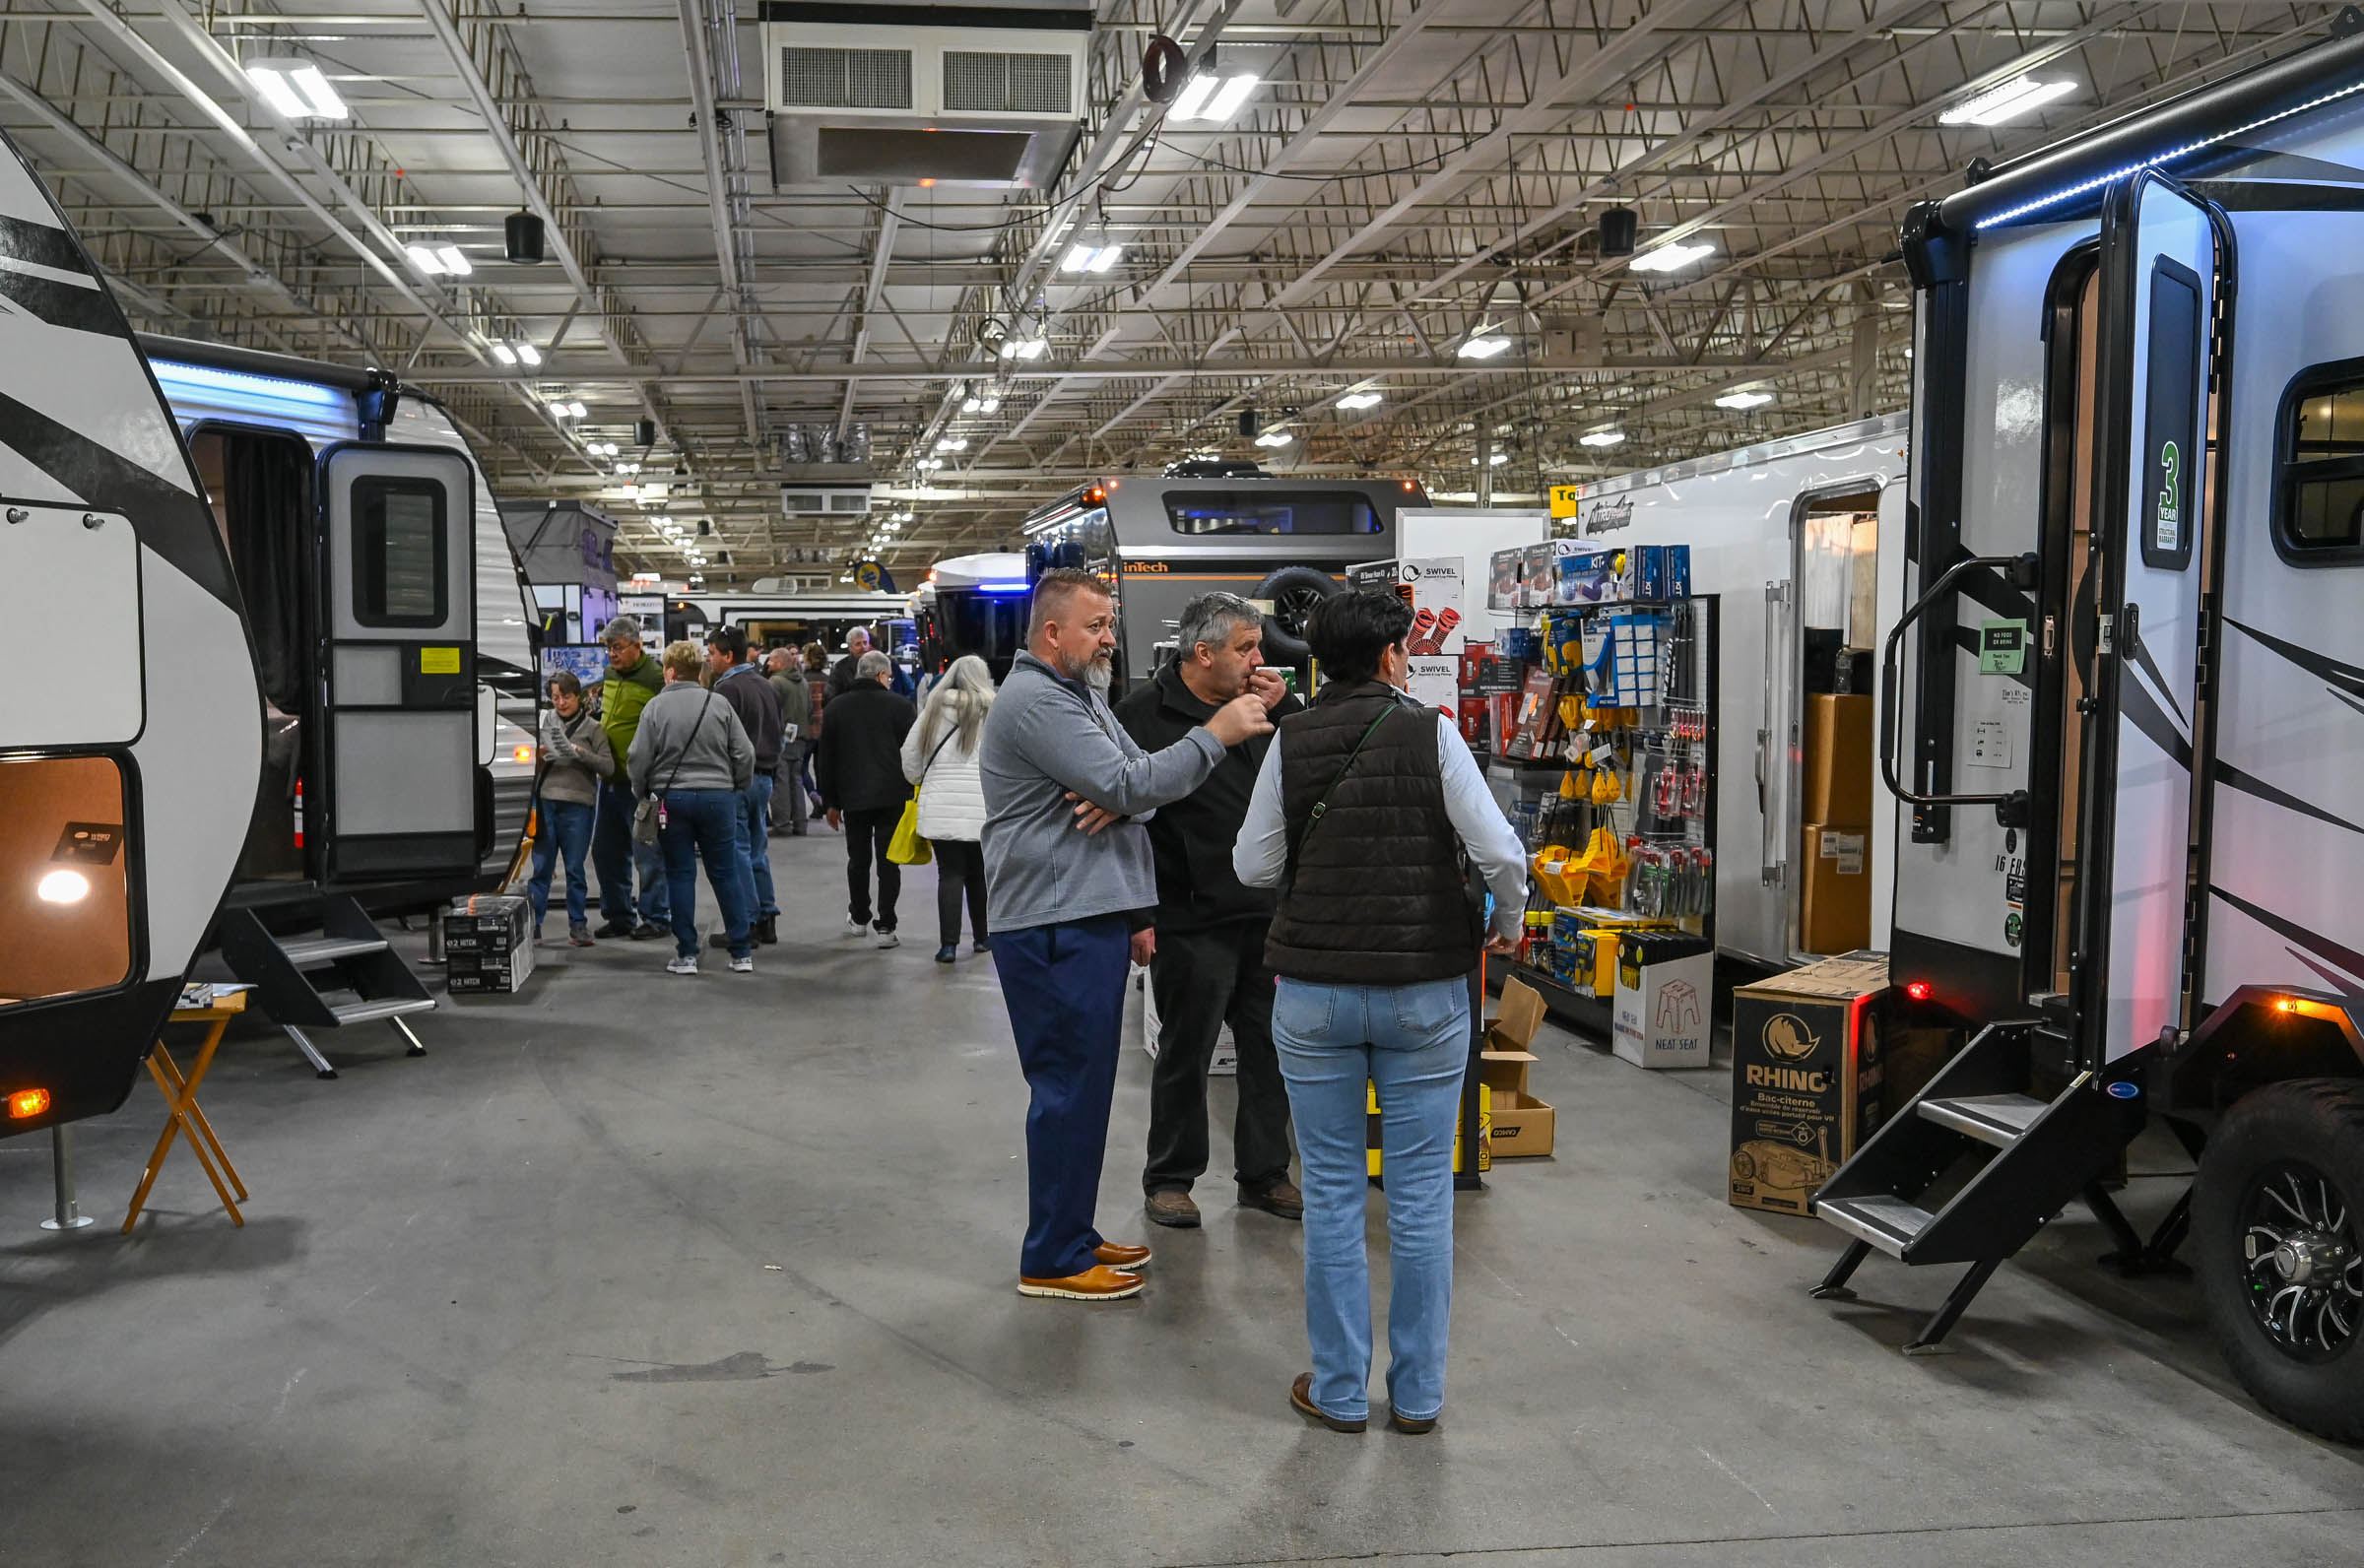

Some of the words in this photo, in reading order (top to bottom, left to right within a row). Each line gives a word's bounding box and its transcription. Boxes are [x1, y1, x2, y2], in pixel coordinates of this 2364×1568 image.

[2160, 440, 2179, 507] 3
[1590, 508, 1611, 524] NITRO
[2160, 506, 2177, 521] YEAR
[1123, 561, 1168, 572] inTech
[1995, 854, 2006, 873] 16
[1655, 1038, 1675, 1050] NEAT
[1678, 1038, 1699, 1050] SEAT
[1757, 1092, 1816, 1108] Bac-citerne
